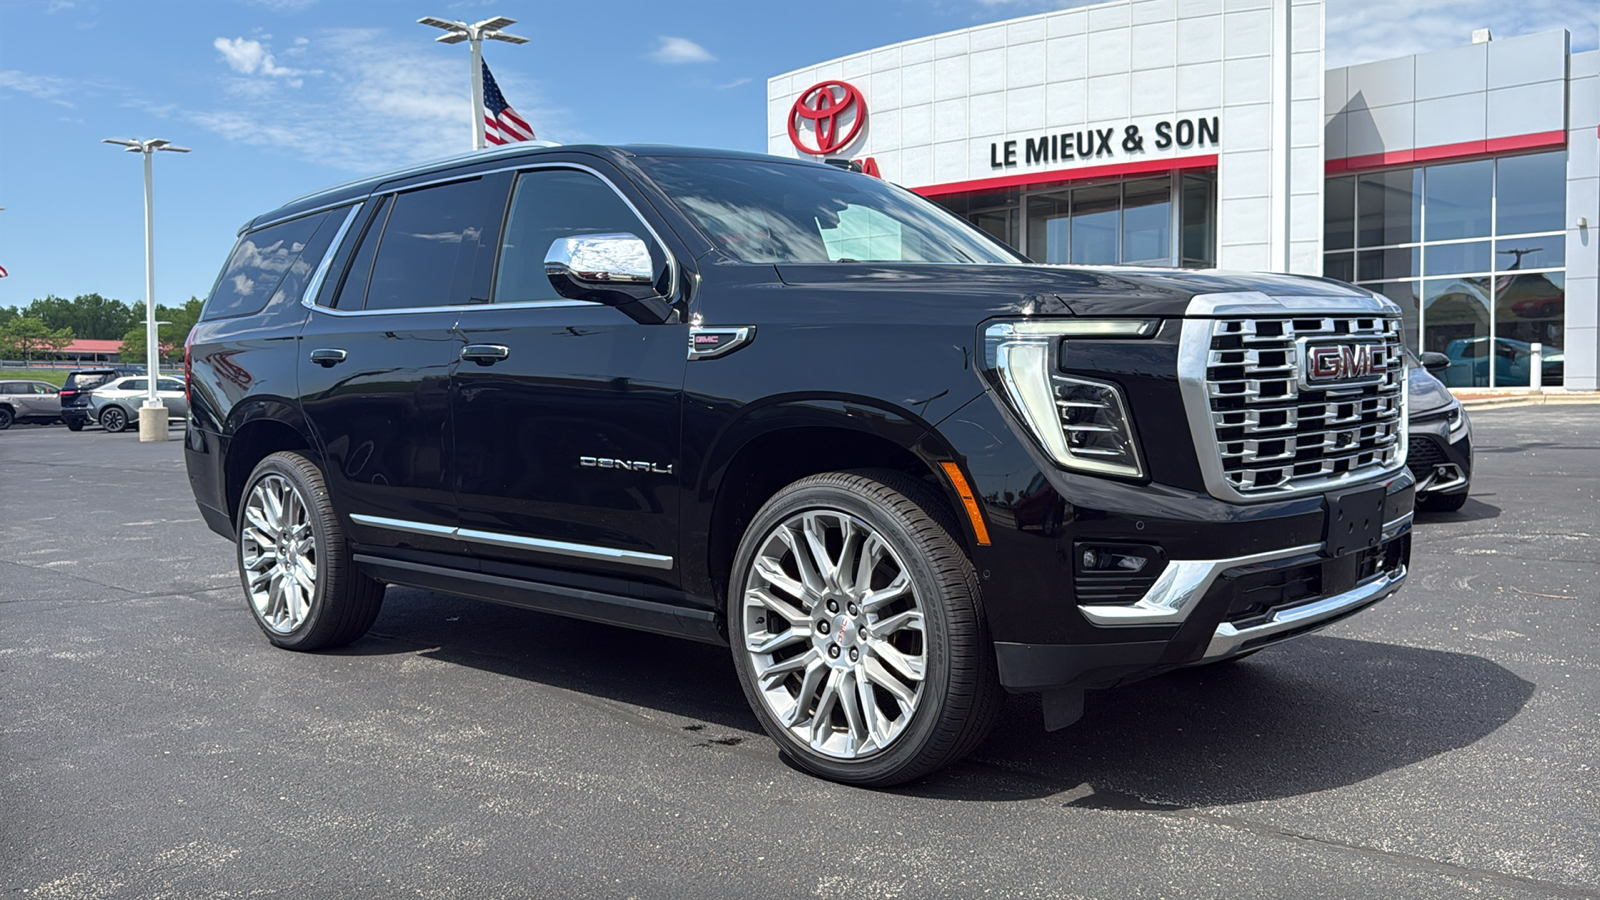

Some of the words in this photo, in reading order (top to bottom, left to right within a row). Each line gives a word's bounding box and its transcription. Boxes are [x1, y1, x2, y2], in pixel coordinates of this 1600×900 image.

[991, 140, 1017, 168] LE
[1025, 128, 1113, 164] MIEUX
[1122, 124, 1144, 153] &
[1155, 116, 1219, 149] SON
[695, 335, 719, 344] GMC
[1308, 344, 1387, 380] GMC
[580, 456, 673, 475] DENALI
[837, 618, 849, 644] GMC
